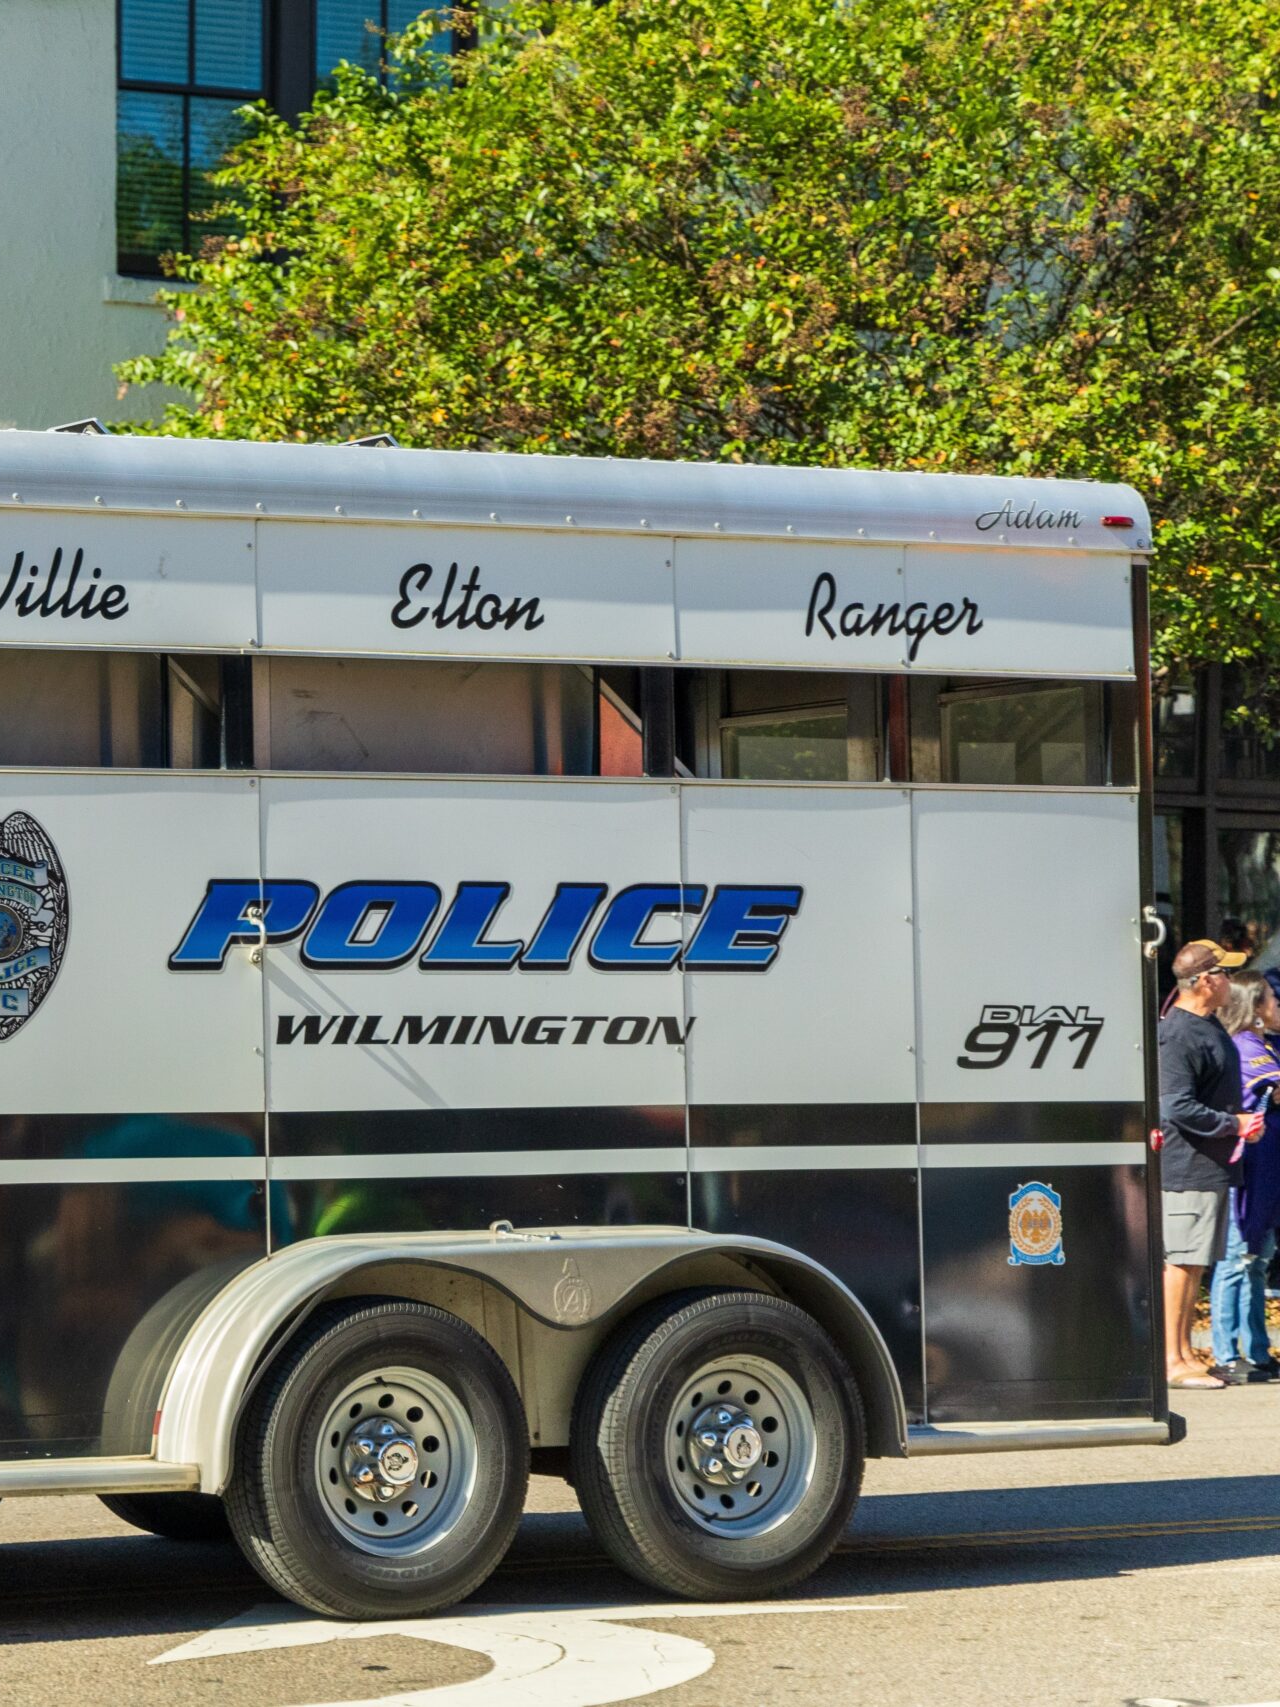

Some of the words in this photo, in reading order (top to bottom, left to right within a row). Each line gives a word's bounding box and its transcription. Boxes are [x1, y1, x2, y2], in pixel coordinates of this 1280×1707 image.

[975, 500, 1082, 531] Adam
[390, 562, 545, 631] Elton
[805, 571, 983, 662] Ranger
[166, 878, 805, 973] POLICE
[276, 1015, 697, 1045] WILMINGTON
[979, 1004, 1105, 1026] DIAL
[956, 1023, 1104, 1070] 911
